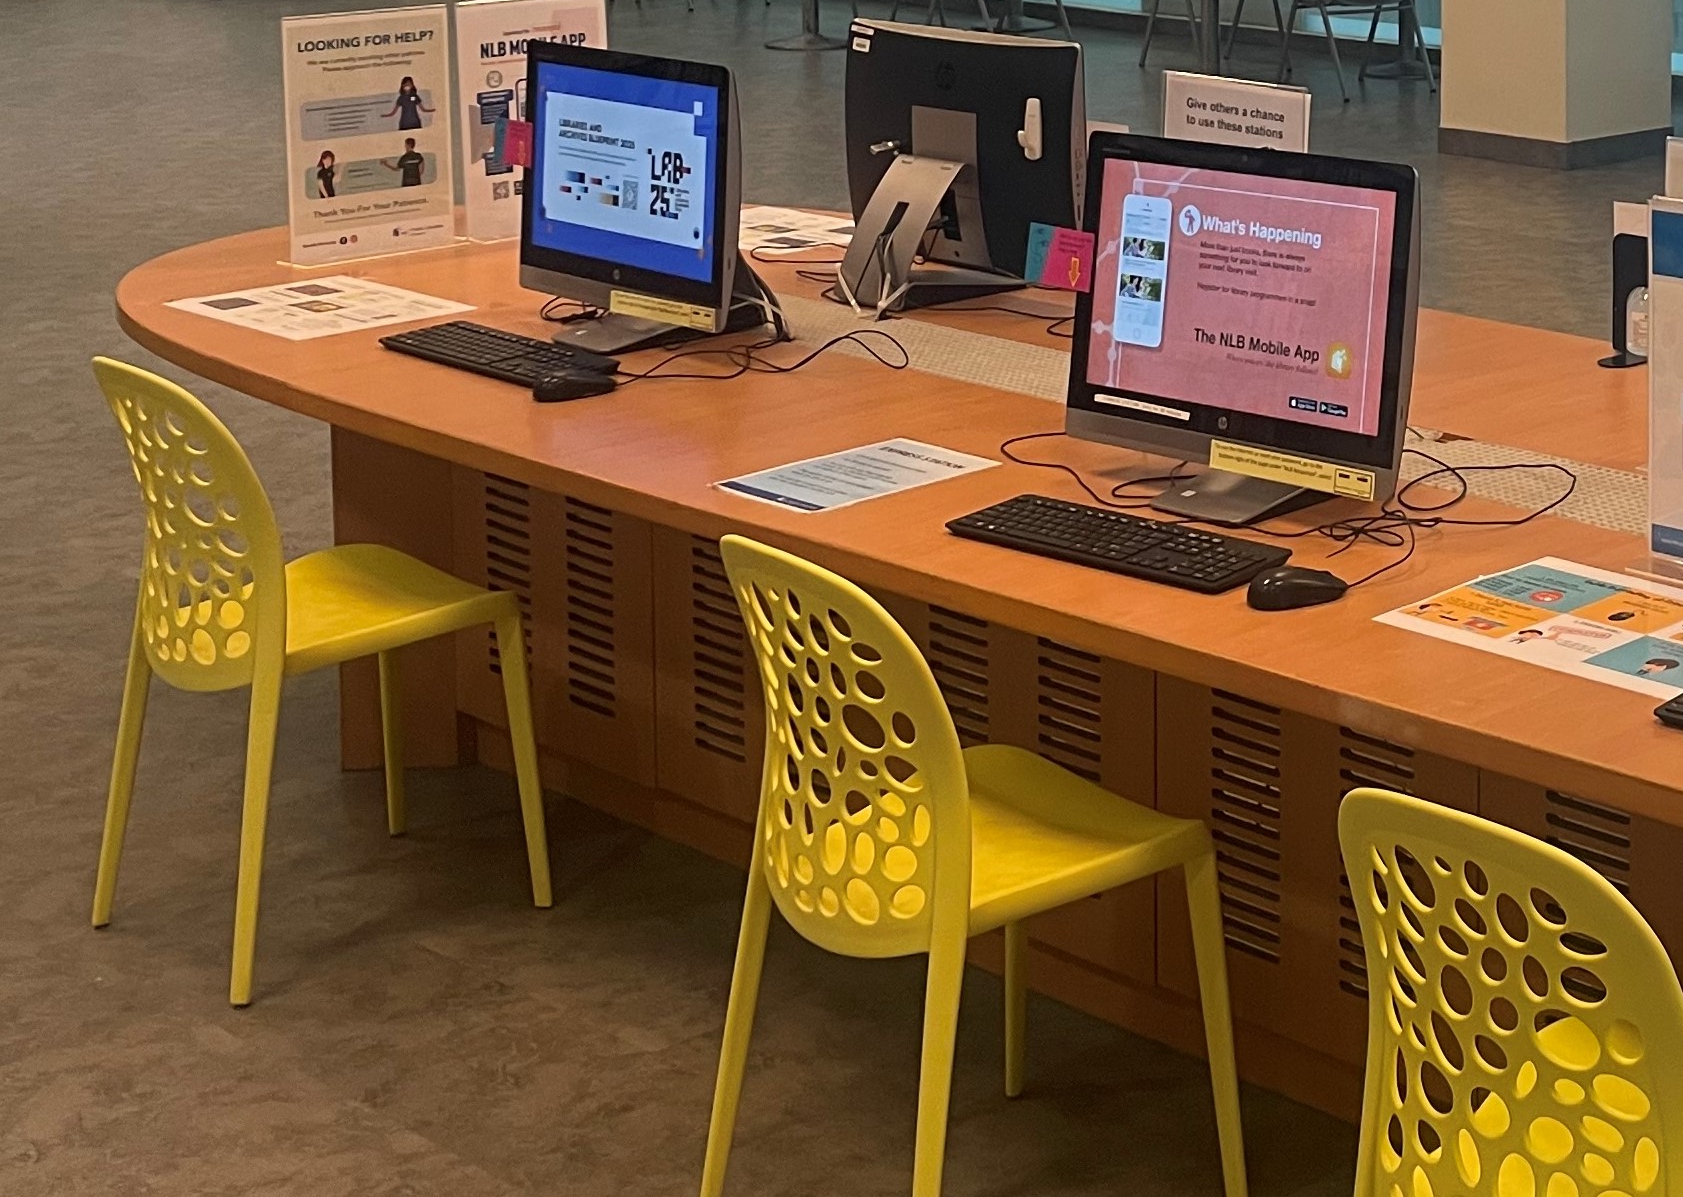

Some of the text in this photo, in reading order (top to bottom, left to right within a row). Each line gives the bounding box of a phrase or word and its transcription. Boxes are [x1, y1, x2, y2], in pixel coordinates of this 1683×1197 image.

[297, 30, 434, 52] LOOKING FOR HELP?
[481, 41, 506, 58] NLB
[1187, 97, 1284, 122] Give others a chance
[1187, 115, 1283, 139] to use these stations
[1202, 214, 1322, 249] What's Happening
[1194, 328, 1215, 344] The
[1220, 332, 1245, 349] NLB
[1248, 337, 1291, 357] Mobile
[1294, 345, 1319, 364] App
